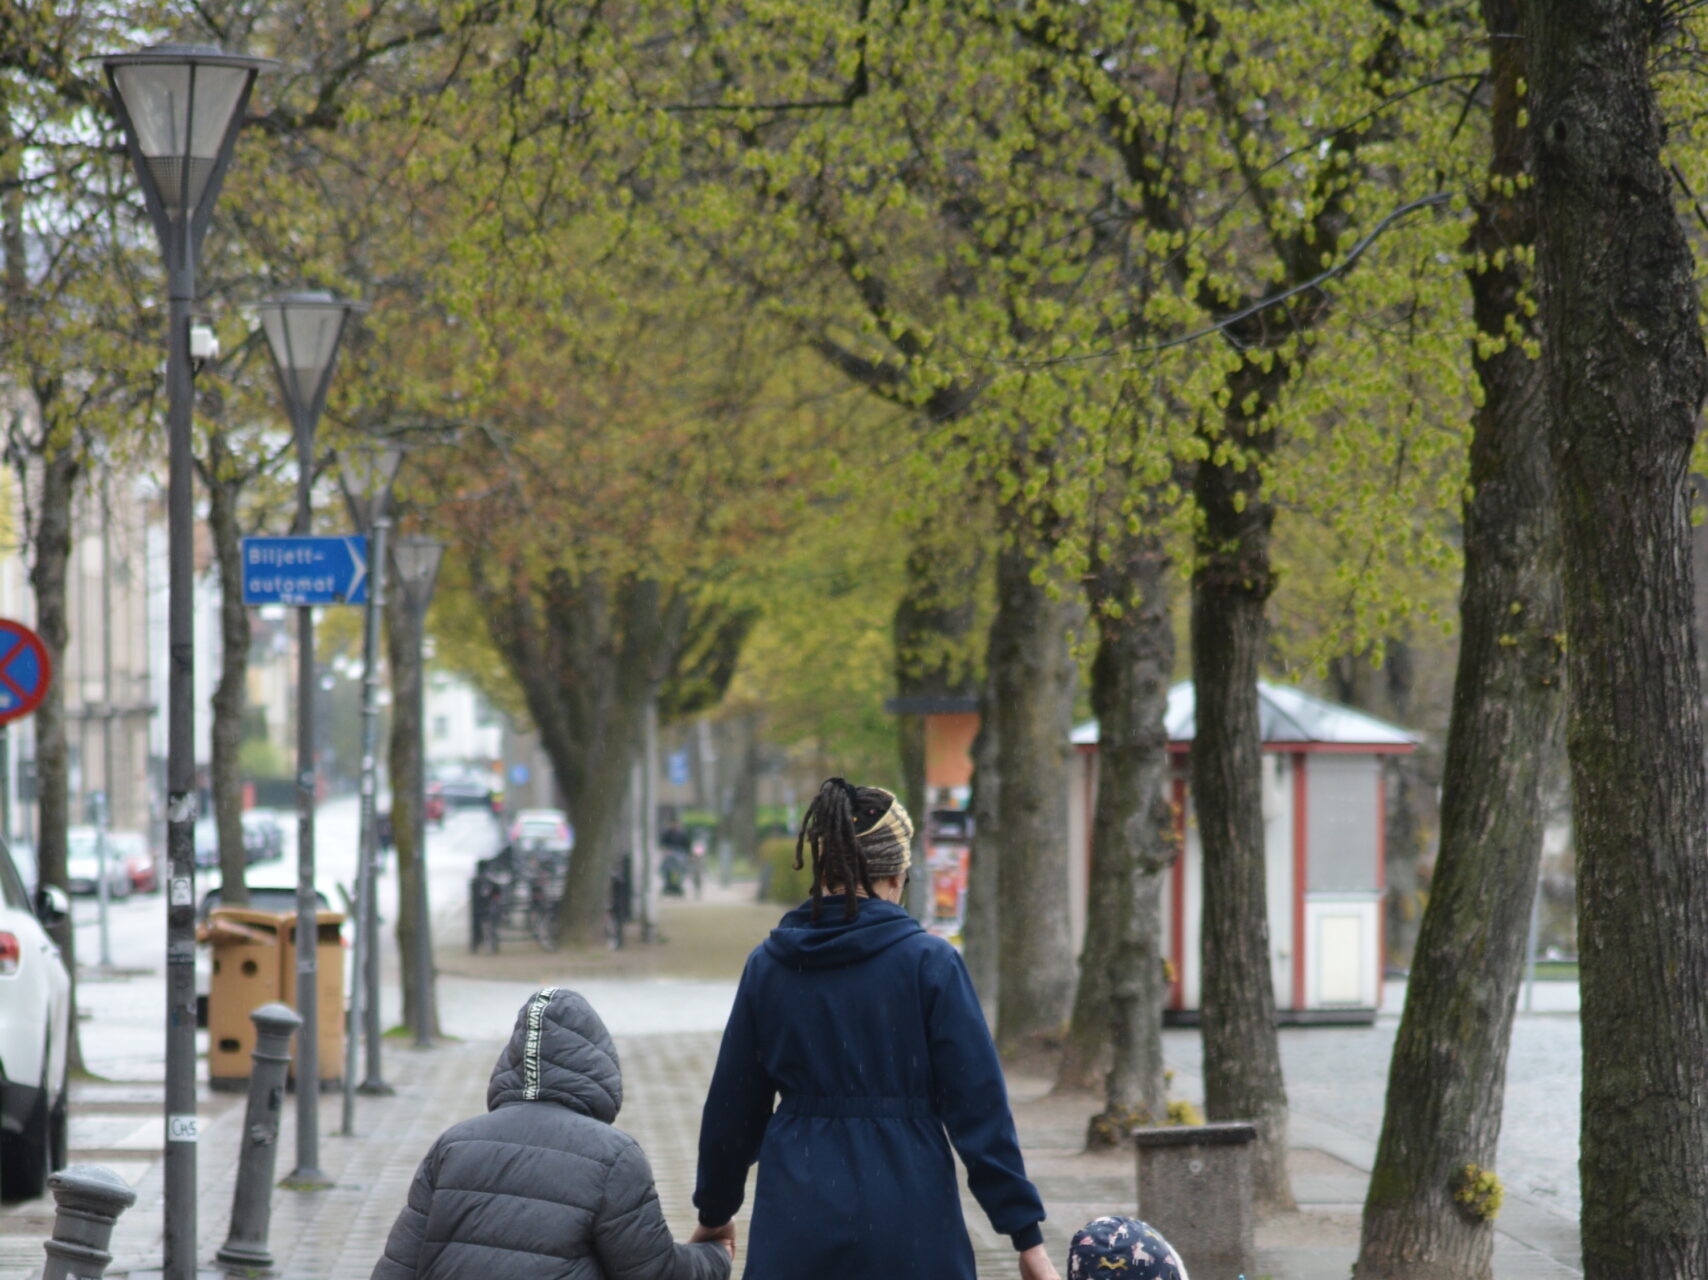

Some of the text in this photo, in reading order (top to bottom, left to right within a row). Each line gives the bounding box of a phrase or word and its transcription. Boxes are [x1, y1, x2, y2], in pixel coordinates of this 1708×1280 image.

[249, 547, 325, 567] Biljett-
[250, 575, 335, 593] automat
[526, 1030, 538, 1057] NEW
